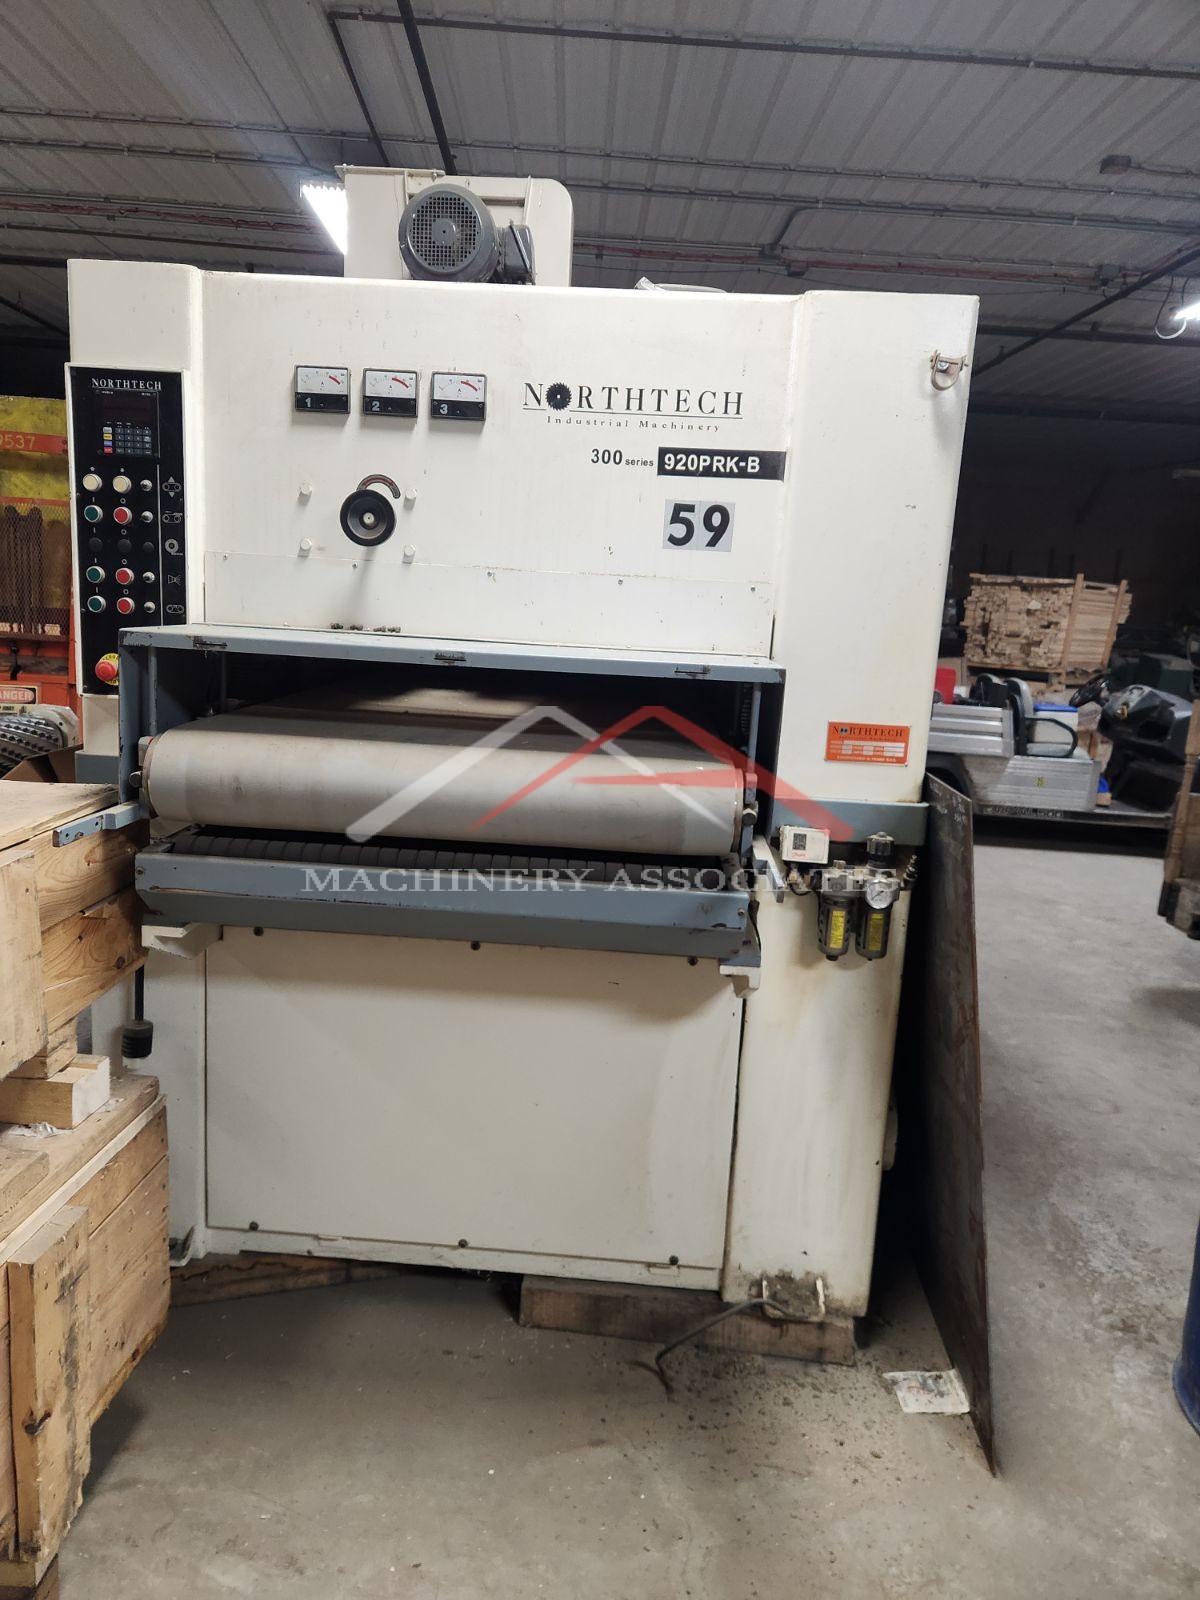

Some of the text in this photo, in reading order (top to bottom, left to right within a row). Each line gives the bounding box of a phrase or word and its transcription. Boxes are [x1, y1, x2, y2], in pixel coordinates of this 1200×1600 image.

[91, 378, 162, 390] NORTHTECH
[305, 397, 312, 408] 1
[372, 401, 380, 412] 2
[522, 382, 744, 416] NORTHTECH
[440, 403, 448, 415] 3
[547, 415, 720, 432] Industrial Machinery
[591, 448, 654, 468] 300 series
[664, 453, 760, 473] 920PRK-B
[667, 502, 730, 548] 59
